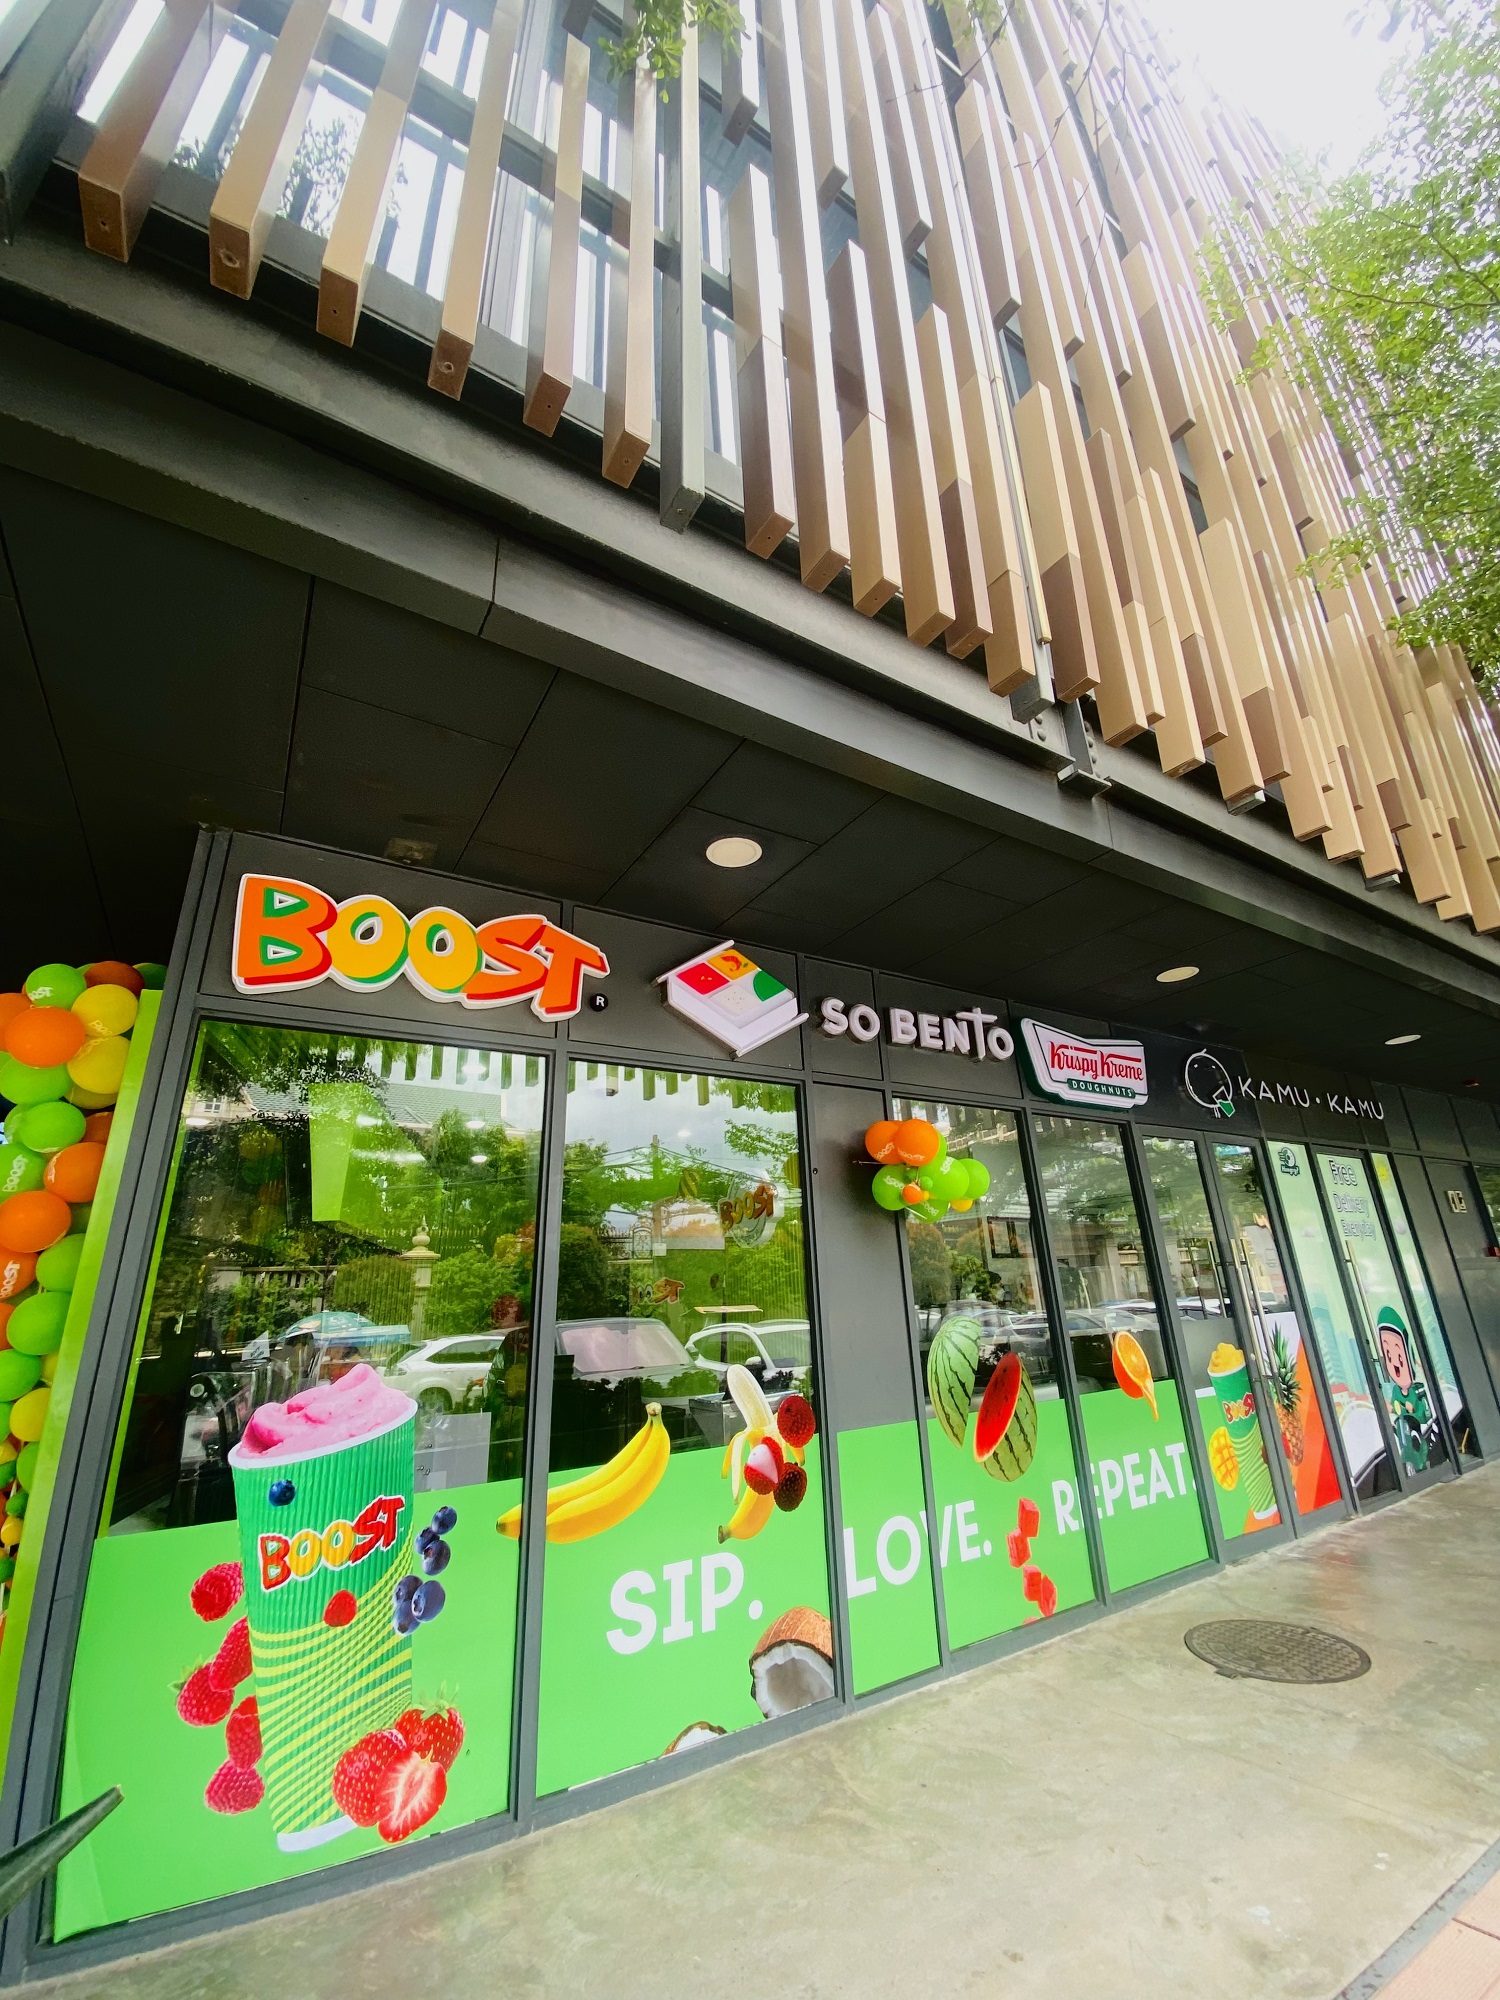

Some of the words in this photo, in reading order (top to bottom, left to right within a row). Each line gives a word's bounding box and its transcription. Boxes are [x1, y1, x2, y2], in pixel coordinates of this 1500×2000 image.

[232, 874, 610, 1022] BOOST
[821, 997, 880, 1042] SO
[889, 1006, 1015, 1061] BENTO
[1048, 1041, 1099, 1080] Krispy
[1099, 1050, 1143, 1080] Kreme
[1071, 1081, 1132, 1097] DOUGHNUTS
[1238, 1076, 1310, 1108] KAMU
[1327, 1092, 1384, 1120] KAMU
[1329, 1159, 1358, 1187] Free
[258, 1495, 405, 1593] BOOST
[606, 1552, 763, 1655] SIP.
